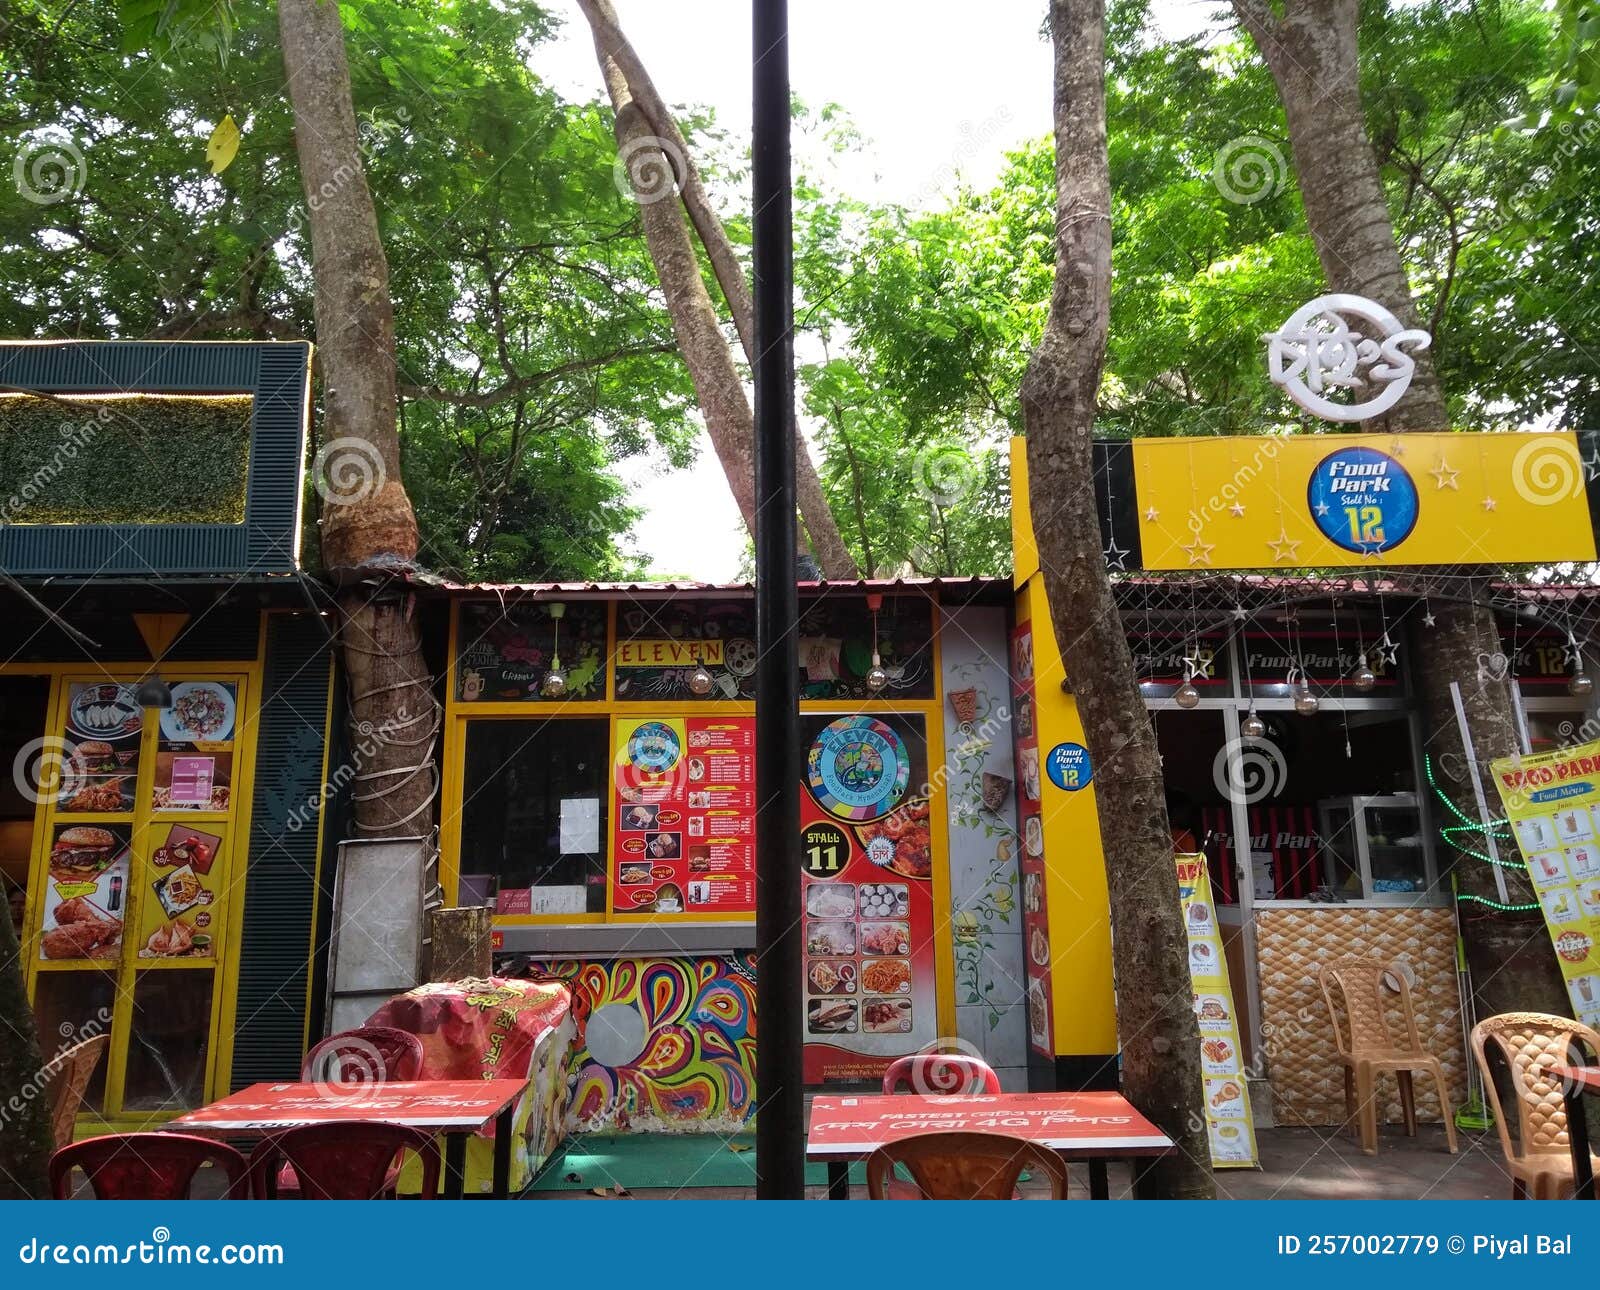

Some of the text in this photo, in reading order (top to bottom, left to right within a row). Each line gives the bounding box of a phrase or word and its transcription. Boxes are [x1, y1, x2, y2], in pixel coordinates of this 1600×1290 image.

[1329, 461, 1388, 477] Food
[1330, 476, 1392, 493] Park
[1344, 505, 1386, 544] 12
[620, 642, 721, 663] ELEVEN
[1248, 653, 1298, 668] Food
[1303, 653, 1355, 668] Park
[1535, 647, 1566, 675] 12
[828, 727, 889, 754] ELEVEN
[1056, 756, 1084, 764] Park
[1061, 769, 1079, 787] 12
[1502, 766, 1554, 790] FOOD
[807, 832, 840, 844] STALL
[806, 845, 839, 871] 11
[880, 1111, 965, 1120] FASTEST
[974, 1117, 1030, 1127] 4G
